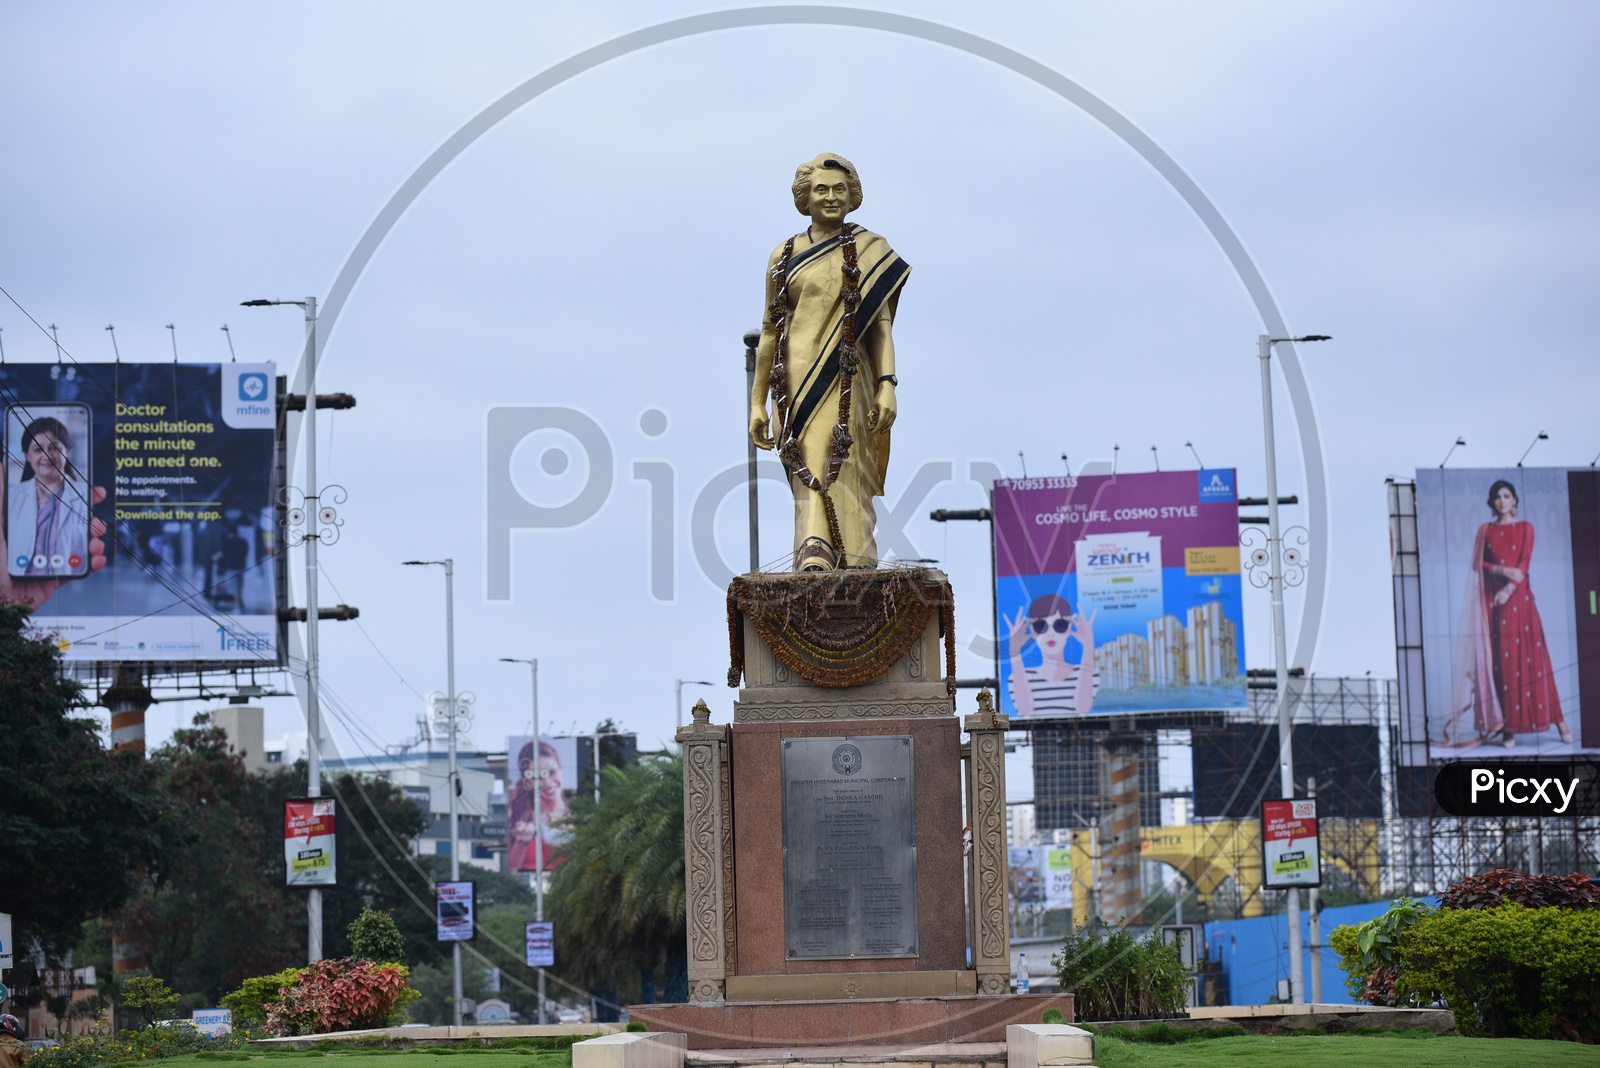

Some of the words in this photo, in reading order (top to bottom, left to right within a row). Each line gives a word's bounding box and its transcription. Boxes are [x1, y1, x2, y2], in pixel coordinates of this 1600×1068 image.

[115, 403, 167, 417] Doctor
[236, 405, 271, 416] mfine
[115, 420, 214, 434] consultations
[115, 437, 140, 451] the
[143, 437, 196, 451] minute
[115, 455, 144, 470] you
[148, 454, 185, 468] need
[189, 456, 222, 468] one.
[115, 475, 130, 485] No
[131, 475, 198, 487] appointments.
[1012, 478, 1045, 491] 70953
[1046, 477, 1078, 490] 33335
[115, 487, 130, 497] No
[131, 487, 168, 499] waiting.
[115, 510, 174, 521] Download
[176, 509, 195, 520] the
[197, 511, 222, 523] app.
[1035, 512, 1080, 526] COSMO
[1082, 510, 1111, 525] LIFE,
[1114, 508, 1158, 521] COSMO
[1160, 506, 1198, 519] STYLE
[1056, 505, 1073, 514] LIVE
[1074, 504, 1088, 513] THE
[195, 1015, 221, 1025] GREENERY
